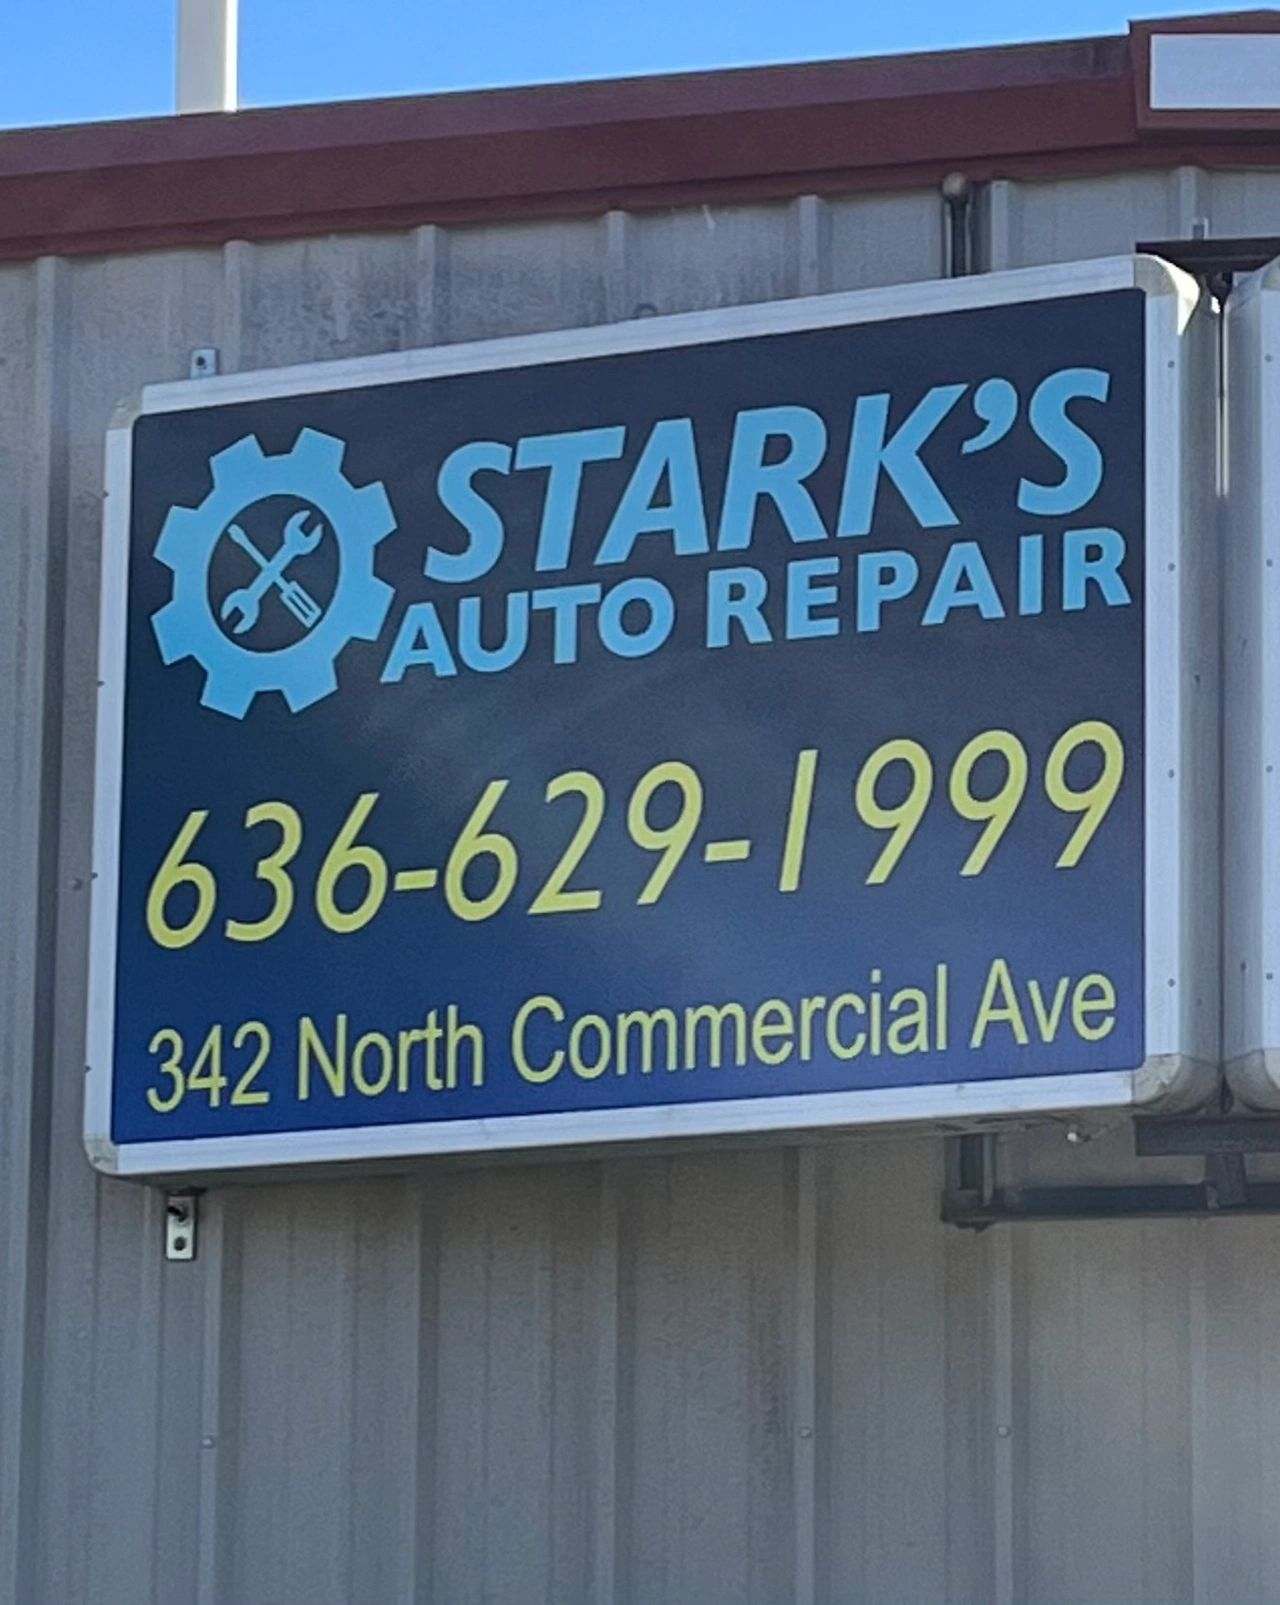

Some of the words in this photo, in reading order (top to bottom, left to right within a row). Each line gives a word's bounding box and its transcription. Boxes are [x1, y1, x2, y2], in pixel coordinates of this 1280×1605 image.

[423, 367, 1110, 584] STARK'S
[379, 577, 675, 684] AUTO
[705, 527, 1132, 650] REPAIR
[146, 719, 1125, 950] 636-629-1999
[146, 1020, 271, 1113] 342
[297, 1003, 484, 1101] North
[511, 962, 949, 1084] Commercial
[968, 957, 1117, 1050] Ave
